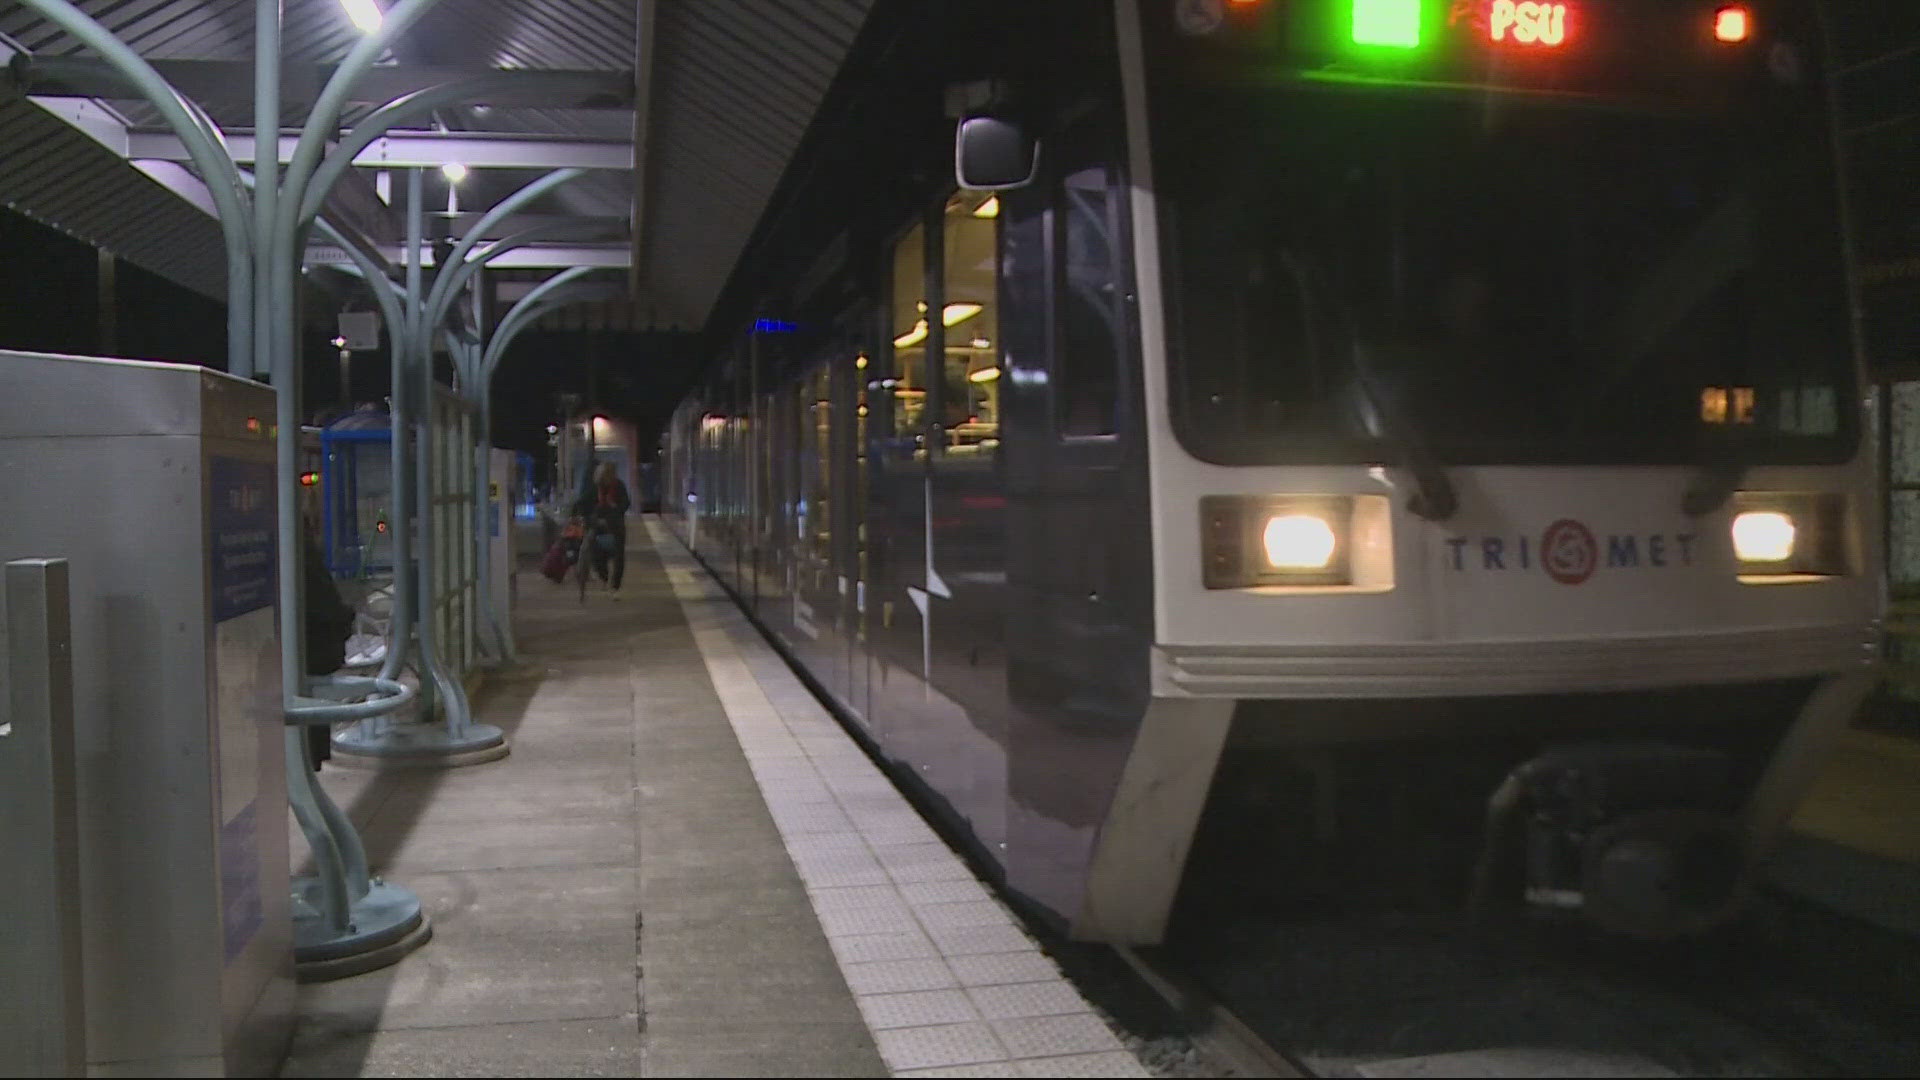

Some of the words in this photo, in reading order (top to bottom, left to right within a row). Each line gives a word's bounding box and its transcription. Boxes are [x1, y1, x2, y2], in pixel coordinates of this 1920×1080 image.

[1490, 0, 1565, 45] PSU
[1446, 536, 1530, 570] TRI
[1606, 533, 1697, 567] MET
